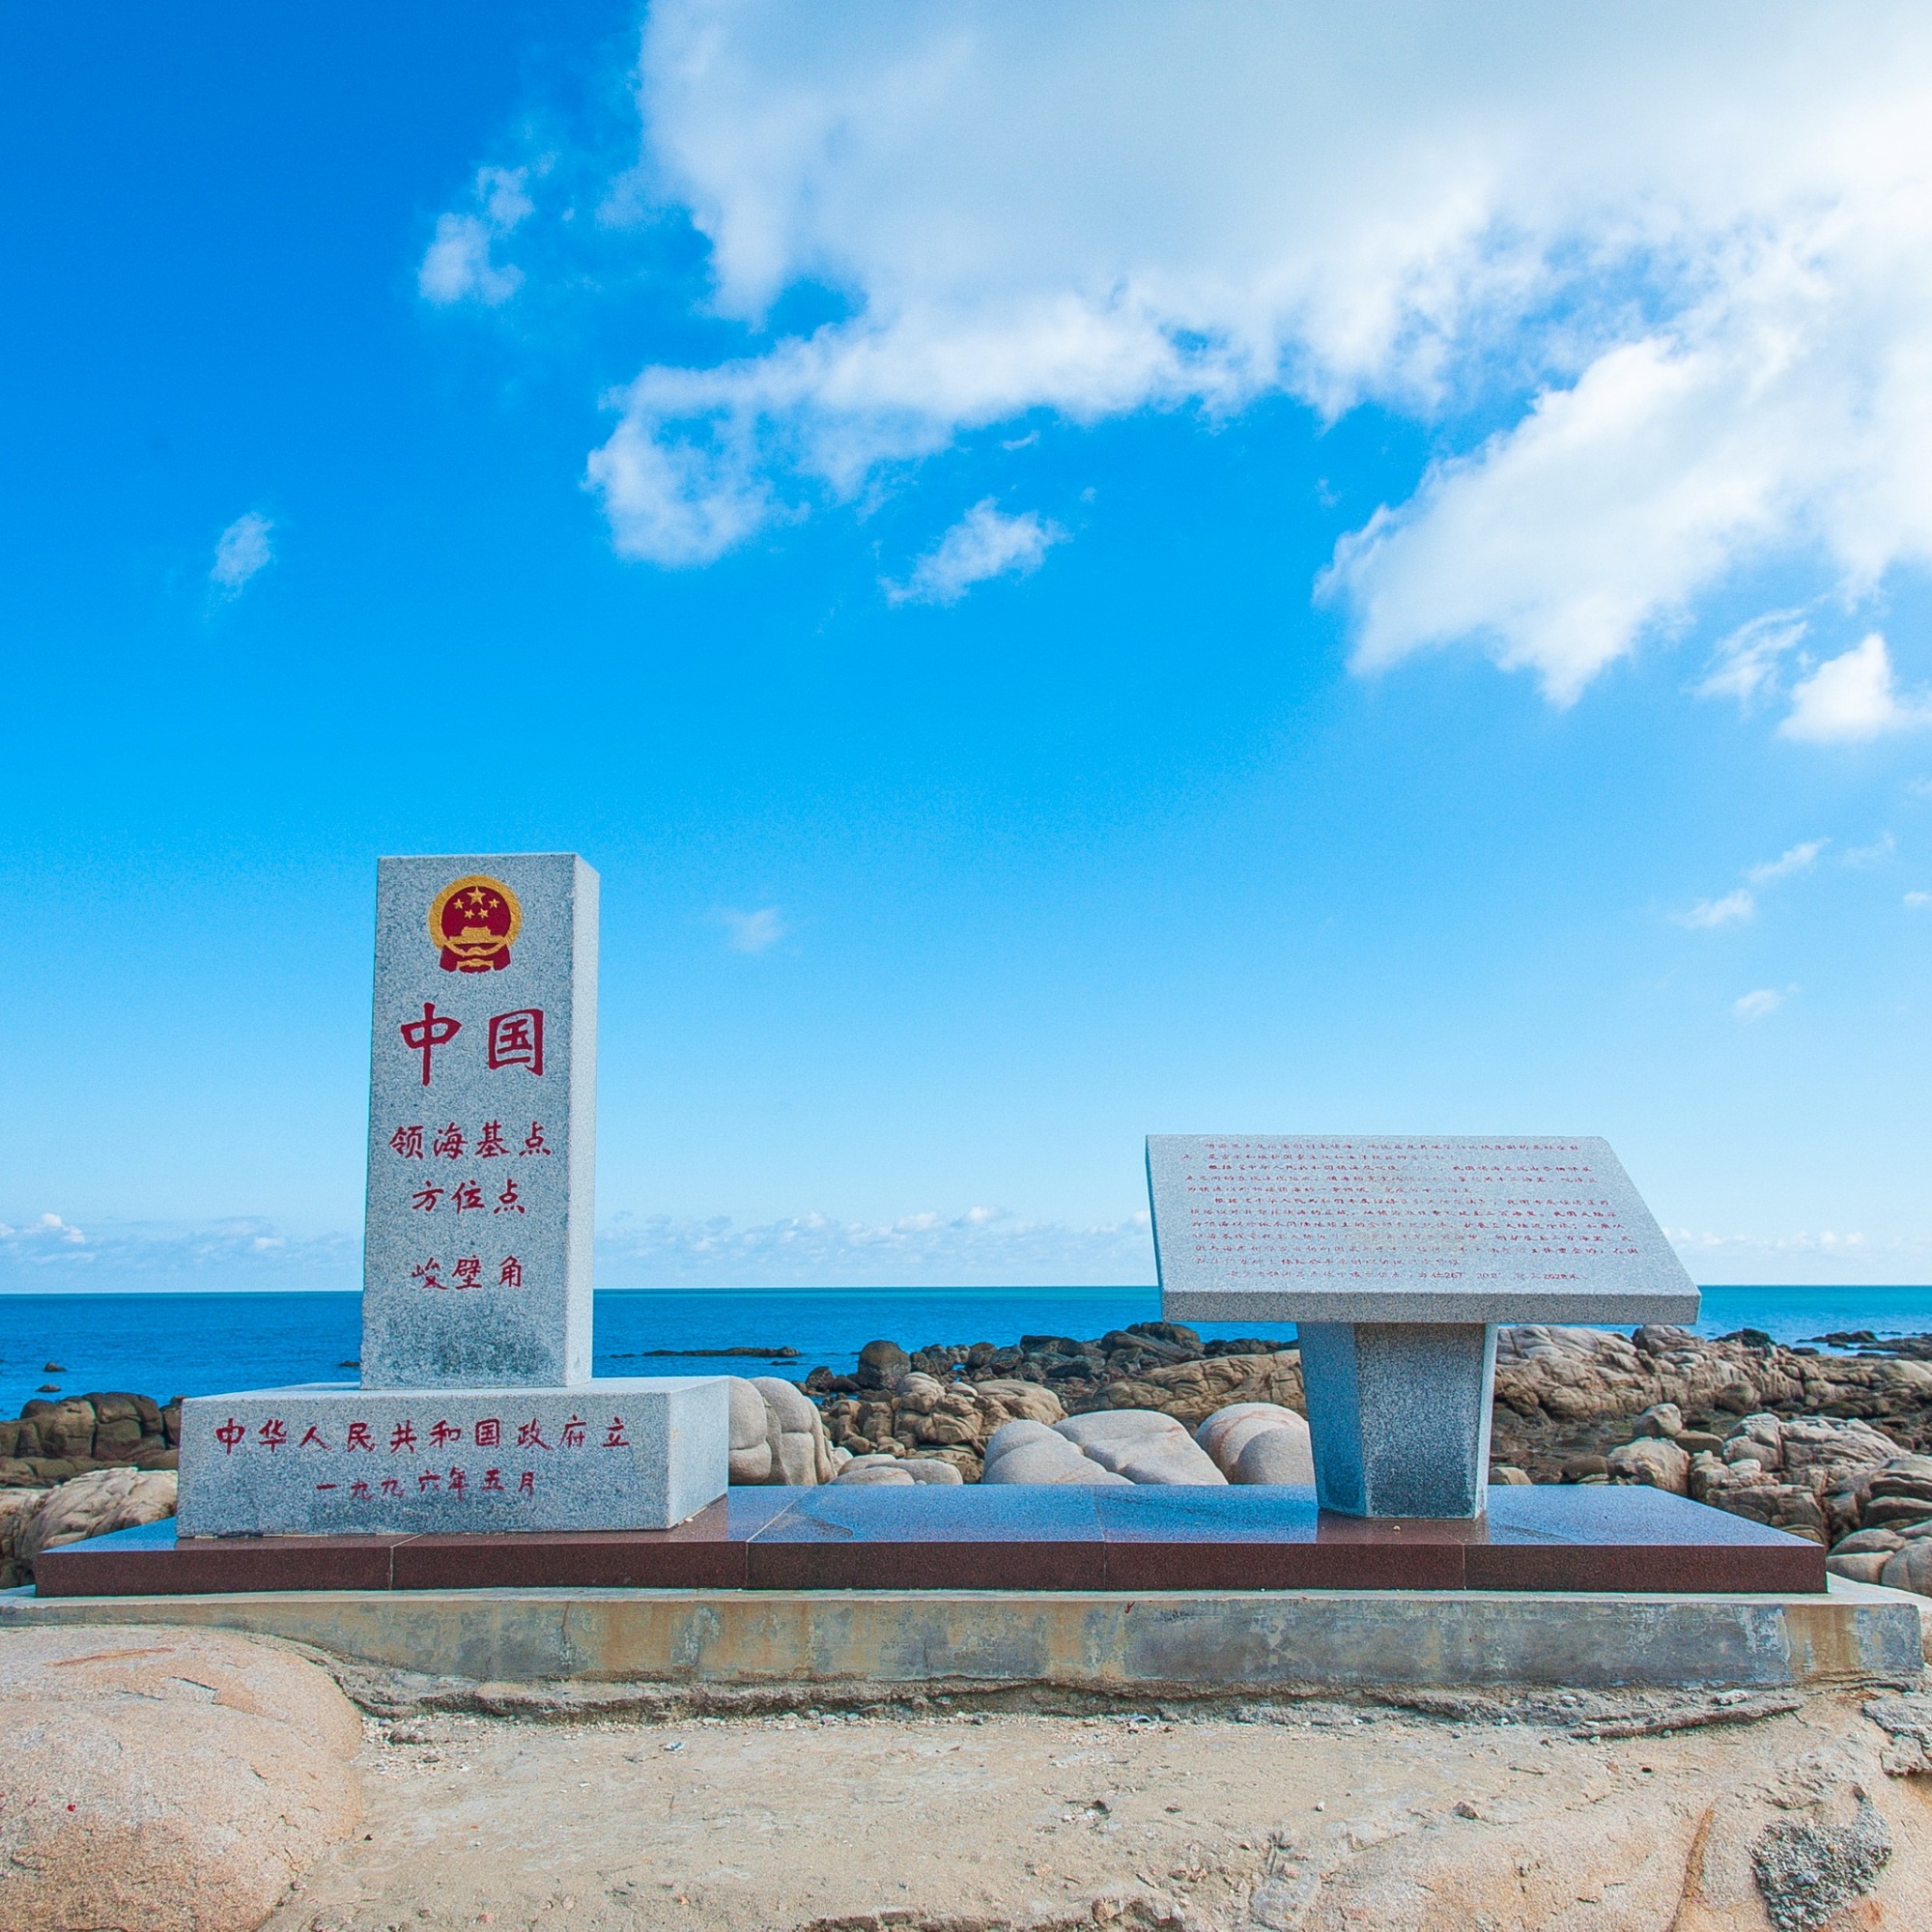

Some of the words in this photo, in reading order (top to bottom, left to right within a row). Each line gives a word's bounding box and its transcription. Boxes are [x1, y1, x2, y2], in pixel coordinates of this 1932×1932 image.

[400, 1002, 544, 1087] 中国
[389, 1120, 552, 1160] 领海基点
[412, 1179, 525, 1214] 方位点
[412, 1255, 523, 1291] 峻壁角
[214, 1415, 631, 1454] 中华人民共和国政府立
[316, 1466, 536, 1502] 一九九六年五月
